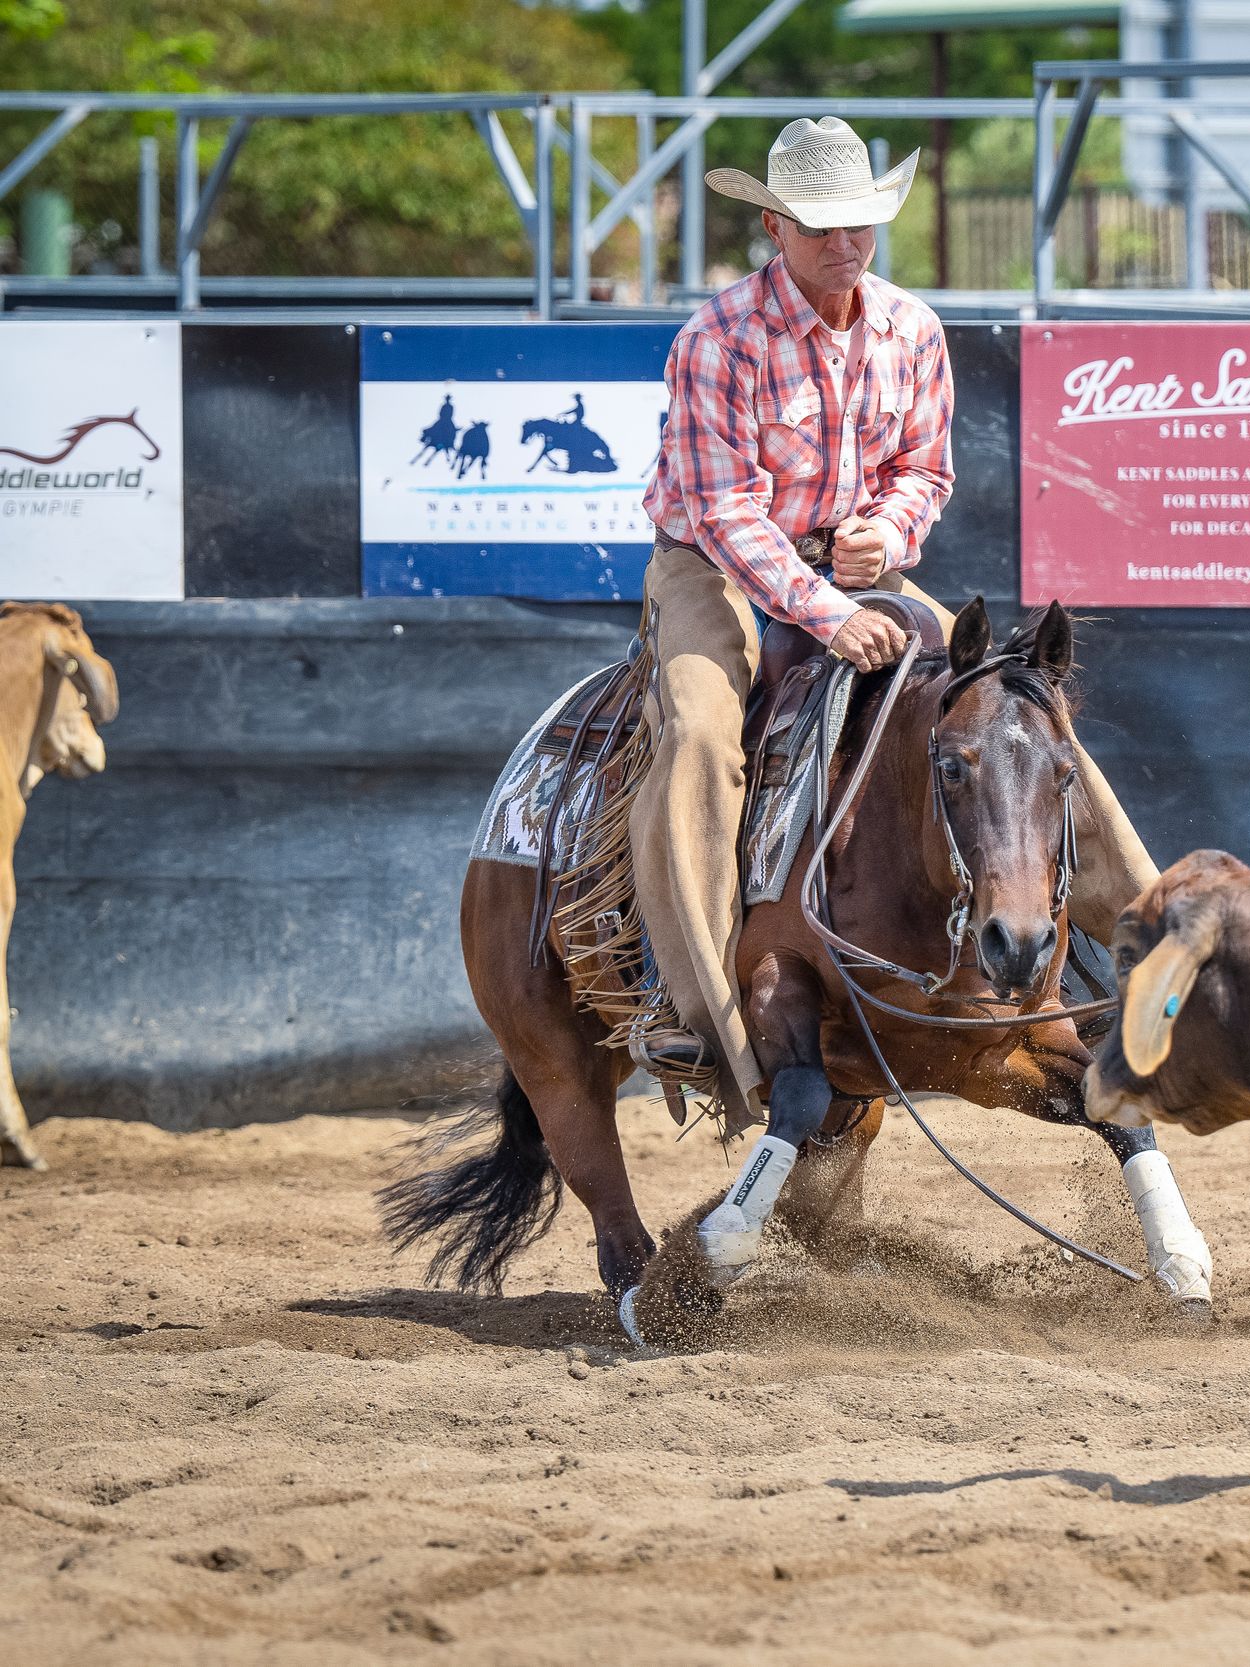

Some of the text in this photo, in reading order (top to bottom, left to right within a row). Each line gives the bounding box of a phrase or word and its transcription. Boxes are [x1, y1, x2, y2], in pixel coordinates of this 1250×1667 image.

[1062, 355, 1184, 418] Kent
[1159, 419, 1227, 438] since
[1117, 467, 1162, 481] KENT
[1165, 467, 1240, 481] SADDLES
[3, 499, 84, 516] GYMPIE
[1163, 494, 1197, 508] FOR
[428, 520, 569, 531] TRAINING
[1170, 521, 1204, 535] FOR
[736, 1150, 771, 1202] ICONOCLAST
